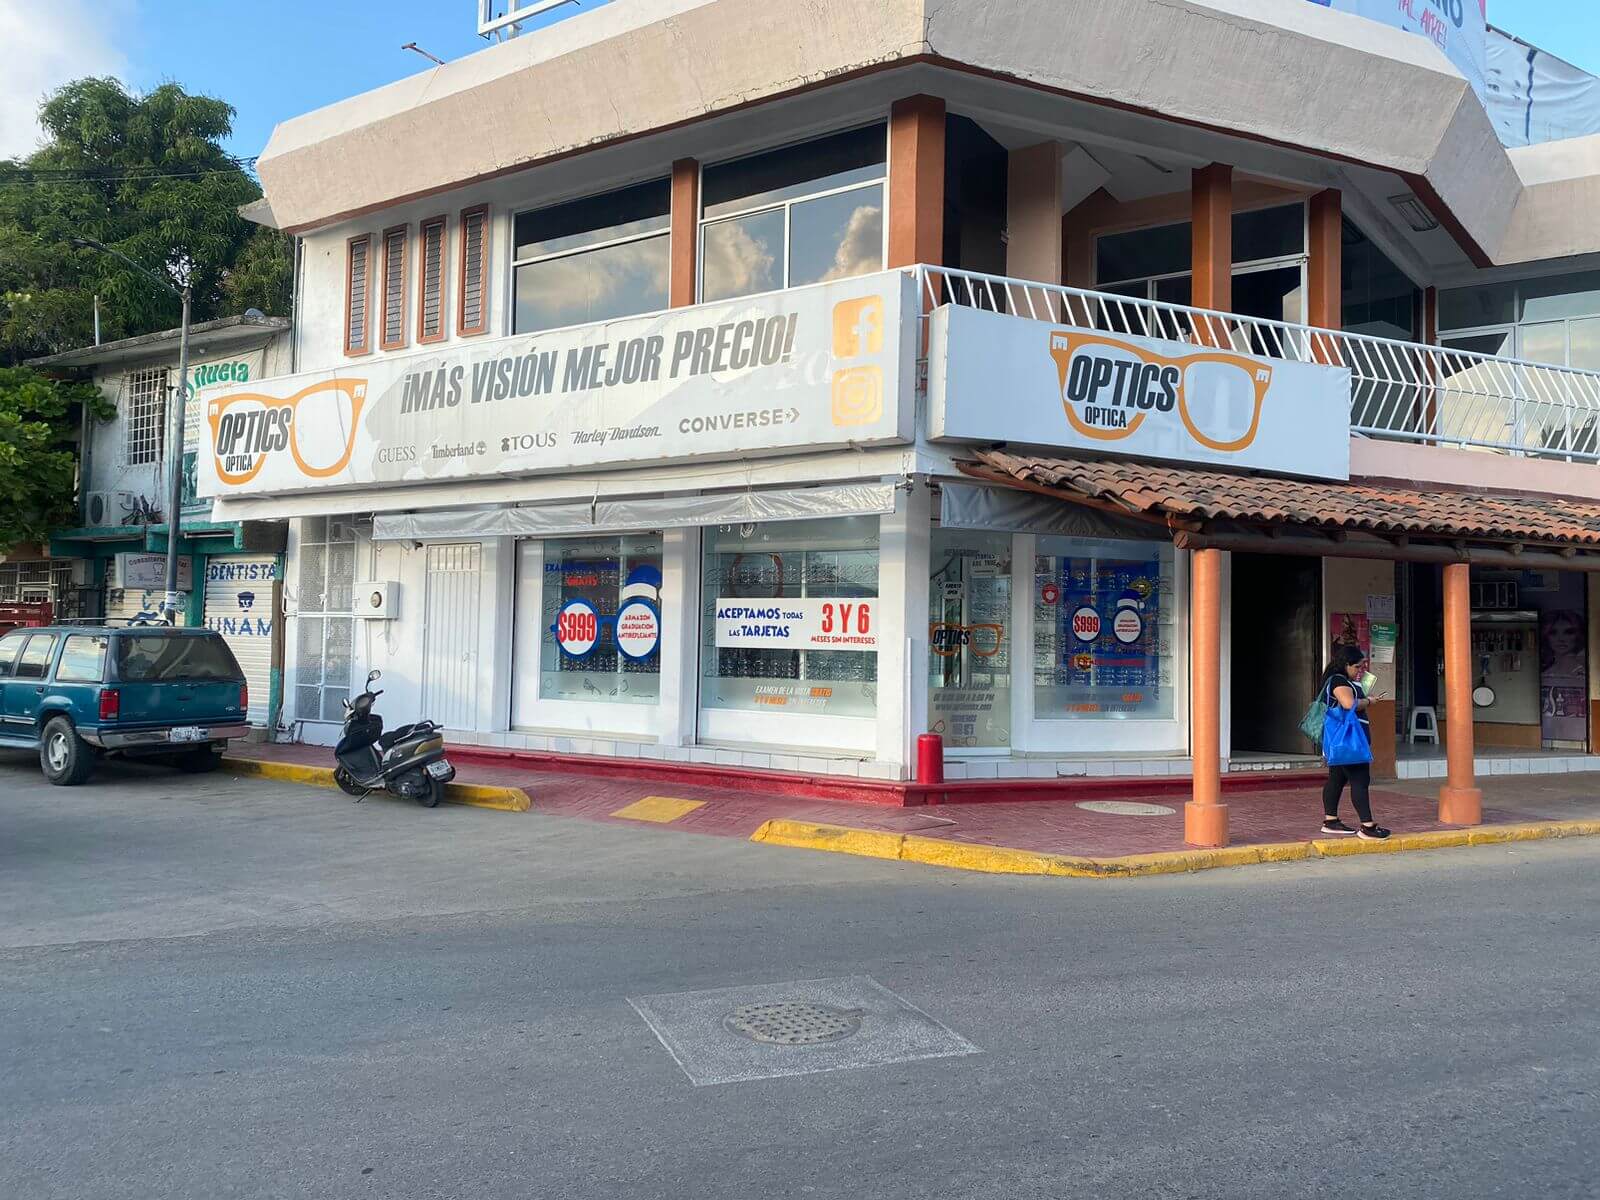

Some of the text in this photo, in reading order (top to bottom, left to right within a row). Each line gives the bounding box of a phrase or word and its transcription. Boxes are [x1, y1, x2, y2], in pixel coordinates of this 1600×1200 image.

[400, 312, 798, 414] ¡MÁS VISIÓN MEJOR PRECIO!
[1067, 354, 1179, 412] OPTICS
[679, 408, 783, 434] CONVERSE
[1085, 406, 1127, 428] OPTICA
[217, 407, 292, 456] OPTICS
[431, 442, 474, 459] Timberland
[511, 433, 557, 450] TOUS
[225, 454, 252, 472] OPTICA
[378, 446, 416, 463] GUESS
[210, 564, 276, 580] DENTISTA
[717, 607, 803, 620] ACEPTAMOS TODAS
[822, 603, 870, 634] 3 Y 6
[209, 617, 272, 636] UNAM
[559, 613, 596, 643] $999
[729, 625, 789, 638] LAS TARJETAS
[1074, 615, 1098, 633] $999
[843, 636, 876, 645] INTERESES
[933, 629, 970, 645] OPTICS
